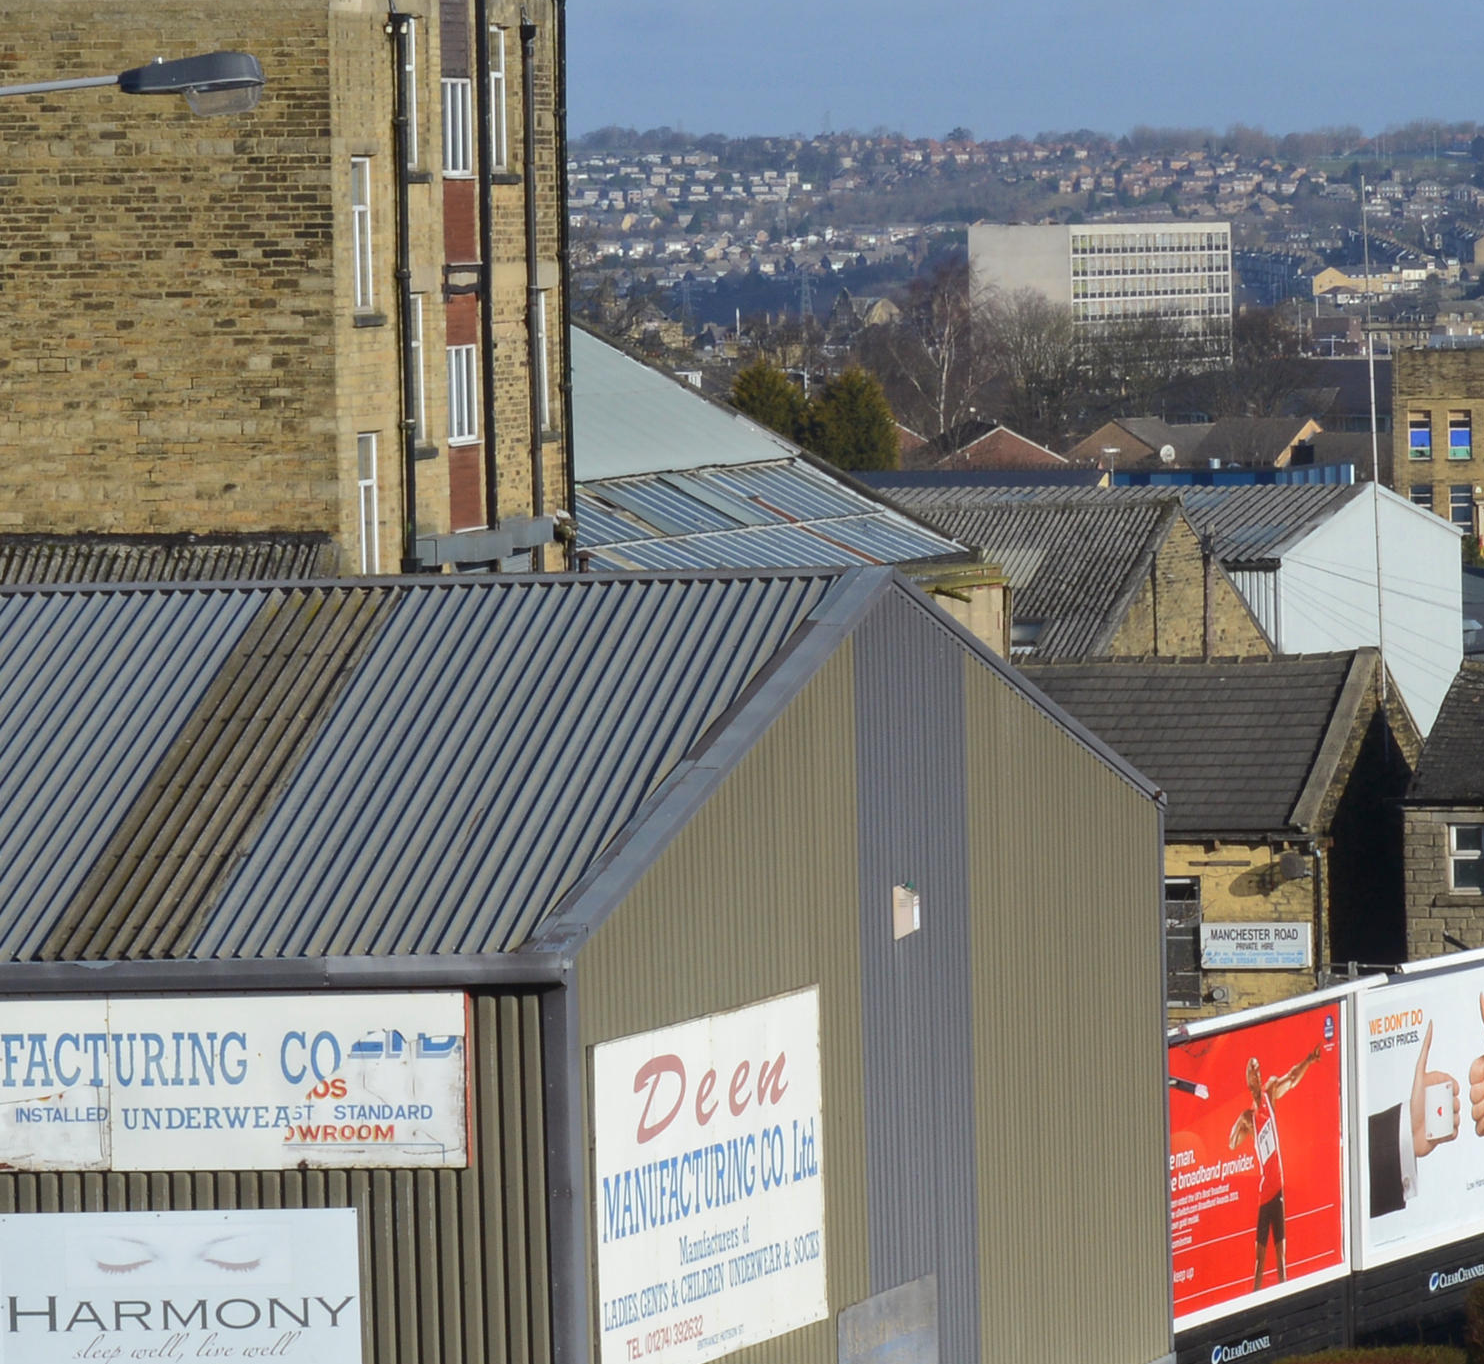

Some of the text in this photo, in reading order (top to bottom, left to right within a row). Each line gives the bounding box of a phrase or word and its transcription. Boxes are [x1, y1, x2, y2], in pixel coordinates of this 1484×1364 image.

[1210, 928, 1299, 941] MANCHESTER ROAD
[1235, 942, 1274, 951] PRIVATE HIRE
[1369, 1009, 1424, 1035] WE DON'T DO
[1369, 1029, 1420, 1053] TRICKSY PRICES.
[1, 1032, 248, 1088] FACTURING
[280, 1031, 342, 1085] CO
[633, 1051, 789, 1145] Deen
[16, 1105, 433, 1130] INSTALLED UNDERWEA STANDARD
[1175, 1149, 1196, 1168] man.
[1178, 1154, 1255, 1190] broadband provider.
[603, 1133, 756, 1244] MANUFACTURING
[760, 1125, 788, 1191] CO.
[679, 1216, 750, 1266] Manufacturers of
[640, 1282, 669, 1319] GENTS
[671, 1279, 679, 1308] &
[680, 1262, 725, 1304] CHILDREN
[728, 1241, 782, 1287] UNDERWEAR
[783, 1240, 791, 1268] &
[794, 1229, 820, 1265] SOCKS
[8, 1295, 356, 1333] HARMONY
[196, 1331, 234, 1359] live
[242, 1330, 302, 1358] well
[626, 1337, 644, 1363] TEL.
[672, 1314, 704, 1349] 392632
